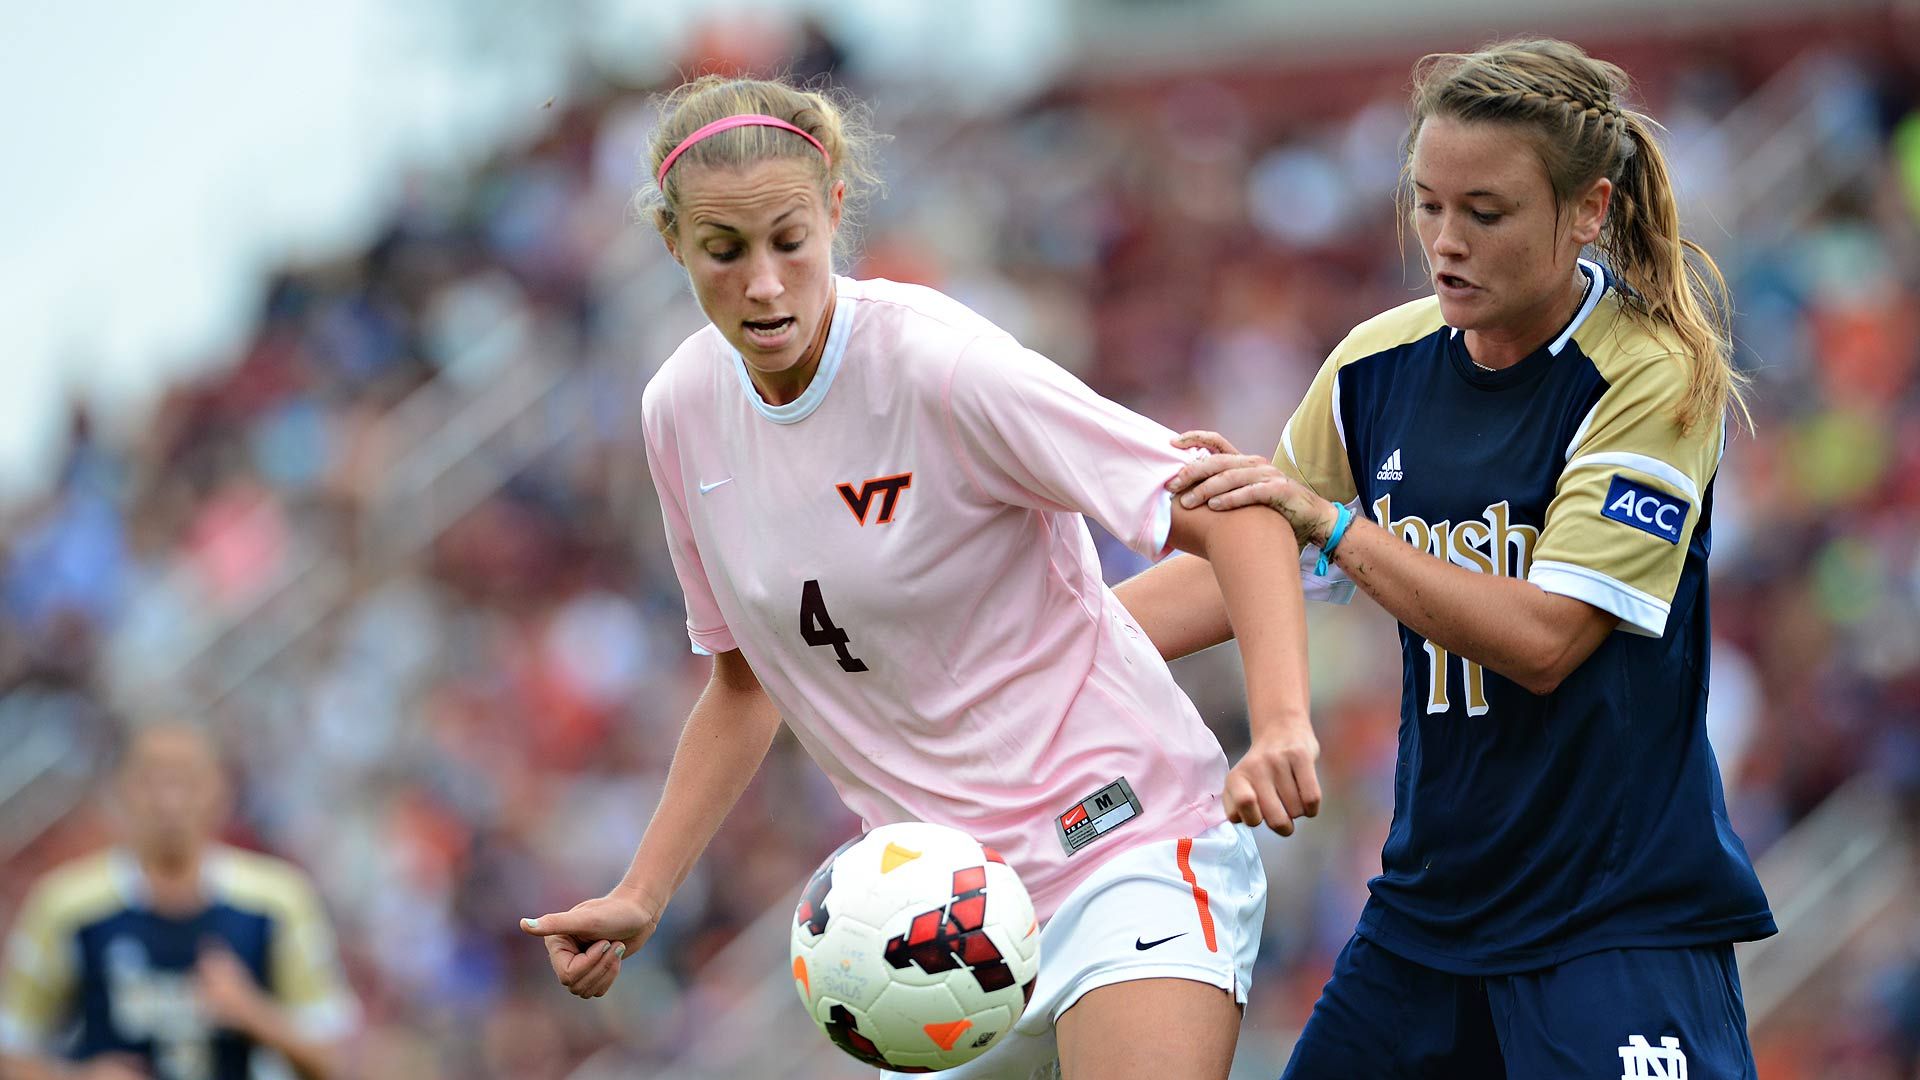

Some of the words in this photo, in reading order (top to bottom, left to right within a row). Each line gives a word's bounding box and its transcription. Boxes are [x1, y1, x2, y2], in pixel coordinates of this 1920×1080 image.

[835, 472, 912, 527] VT
[1376, 469, 1404, 481] adidas
[1608, 489, 1680, 532] ACC
[800, 579, 870, 673] 4
[1422, 638, 1490, 718] 11
[1094, 793, 1114, 811] M
